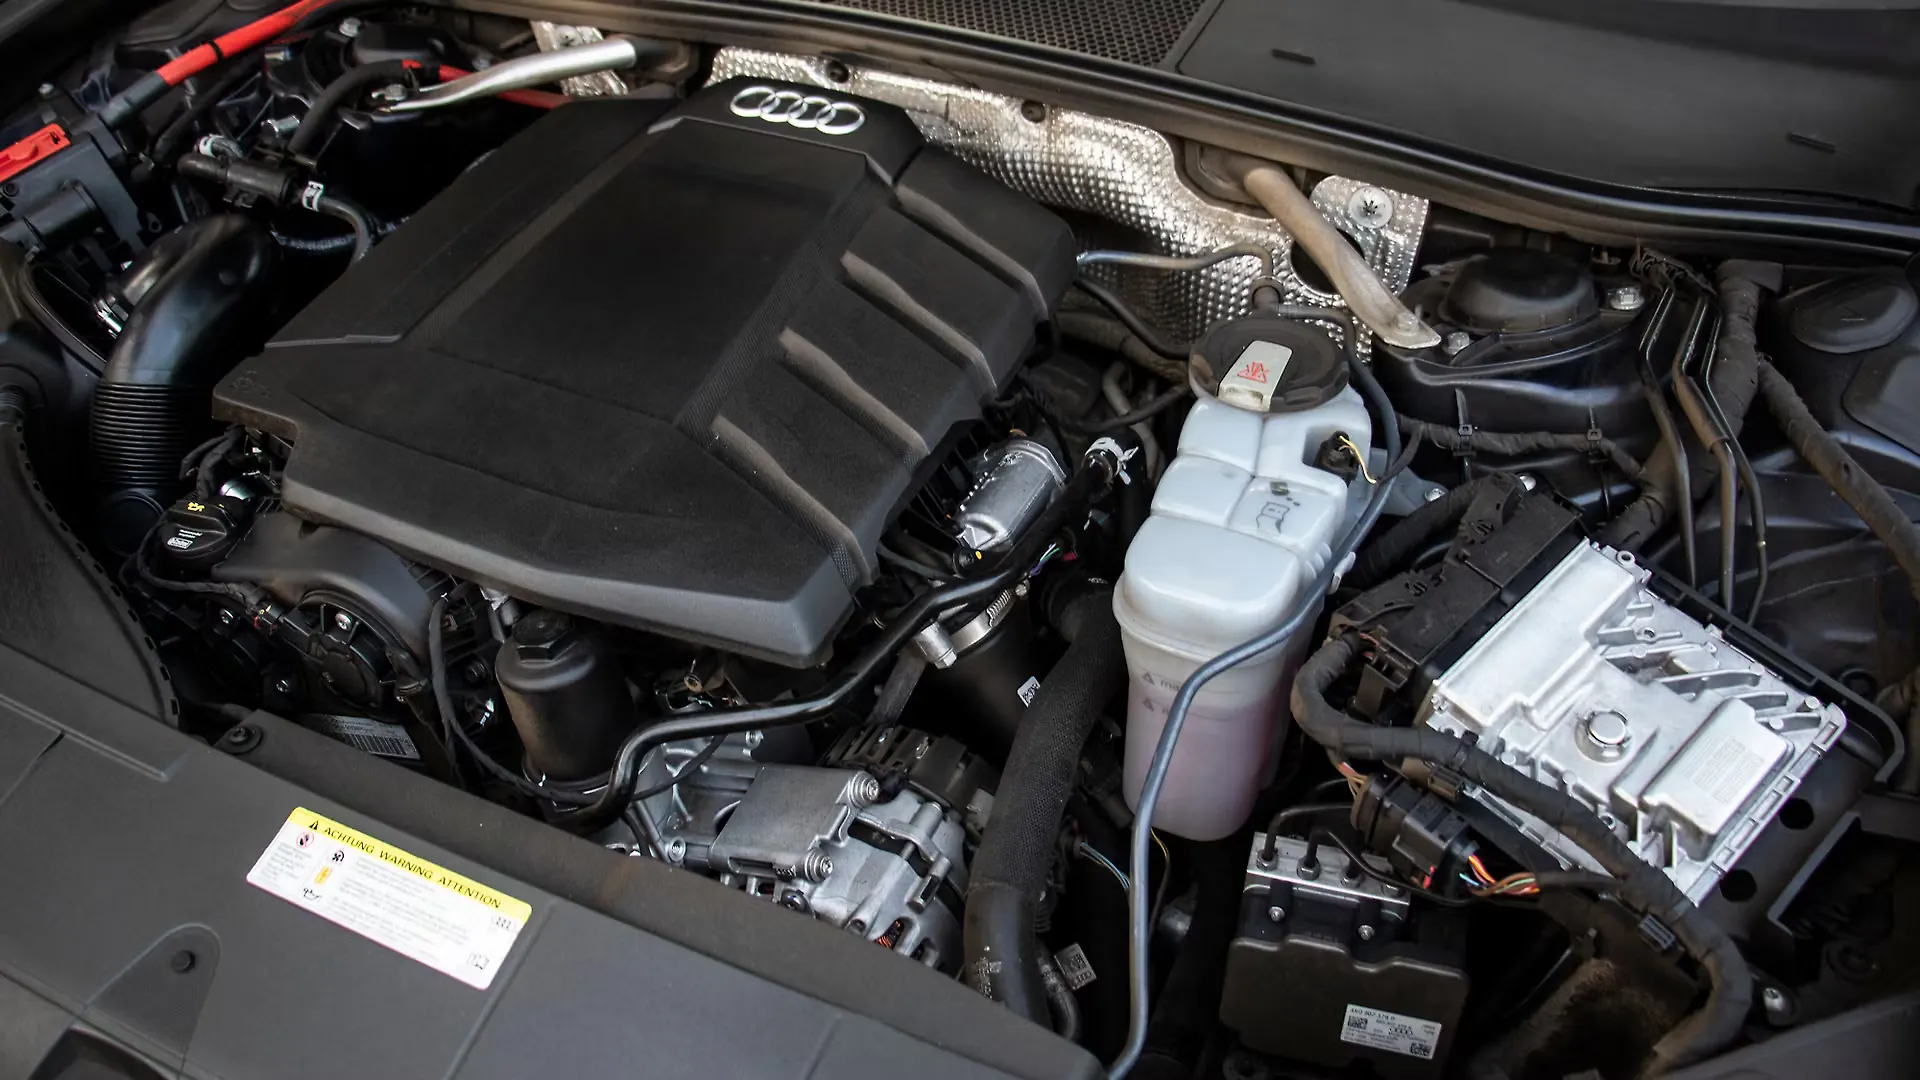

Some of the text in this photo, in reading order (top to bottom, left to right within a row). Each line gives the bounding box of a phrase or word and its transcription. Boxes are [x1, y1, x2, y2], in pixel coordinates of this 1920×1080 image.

[324, 827, 501, 908] ACHTUNG WARNING ATTENTION
